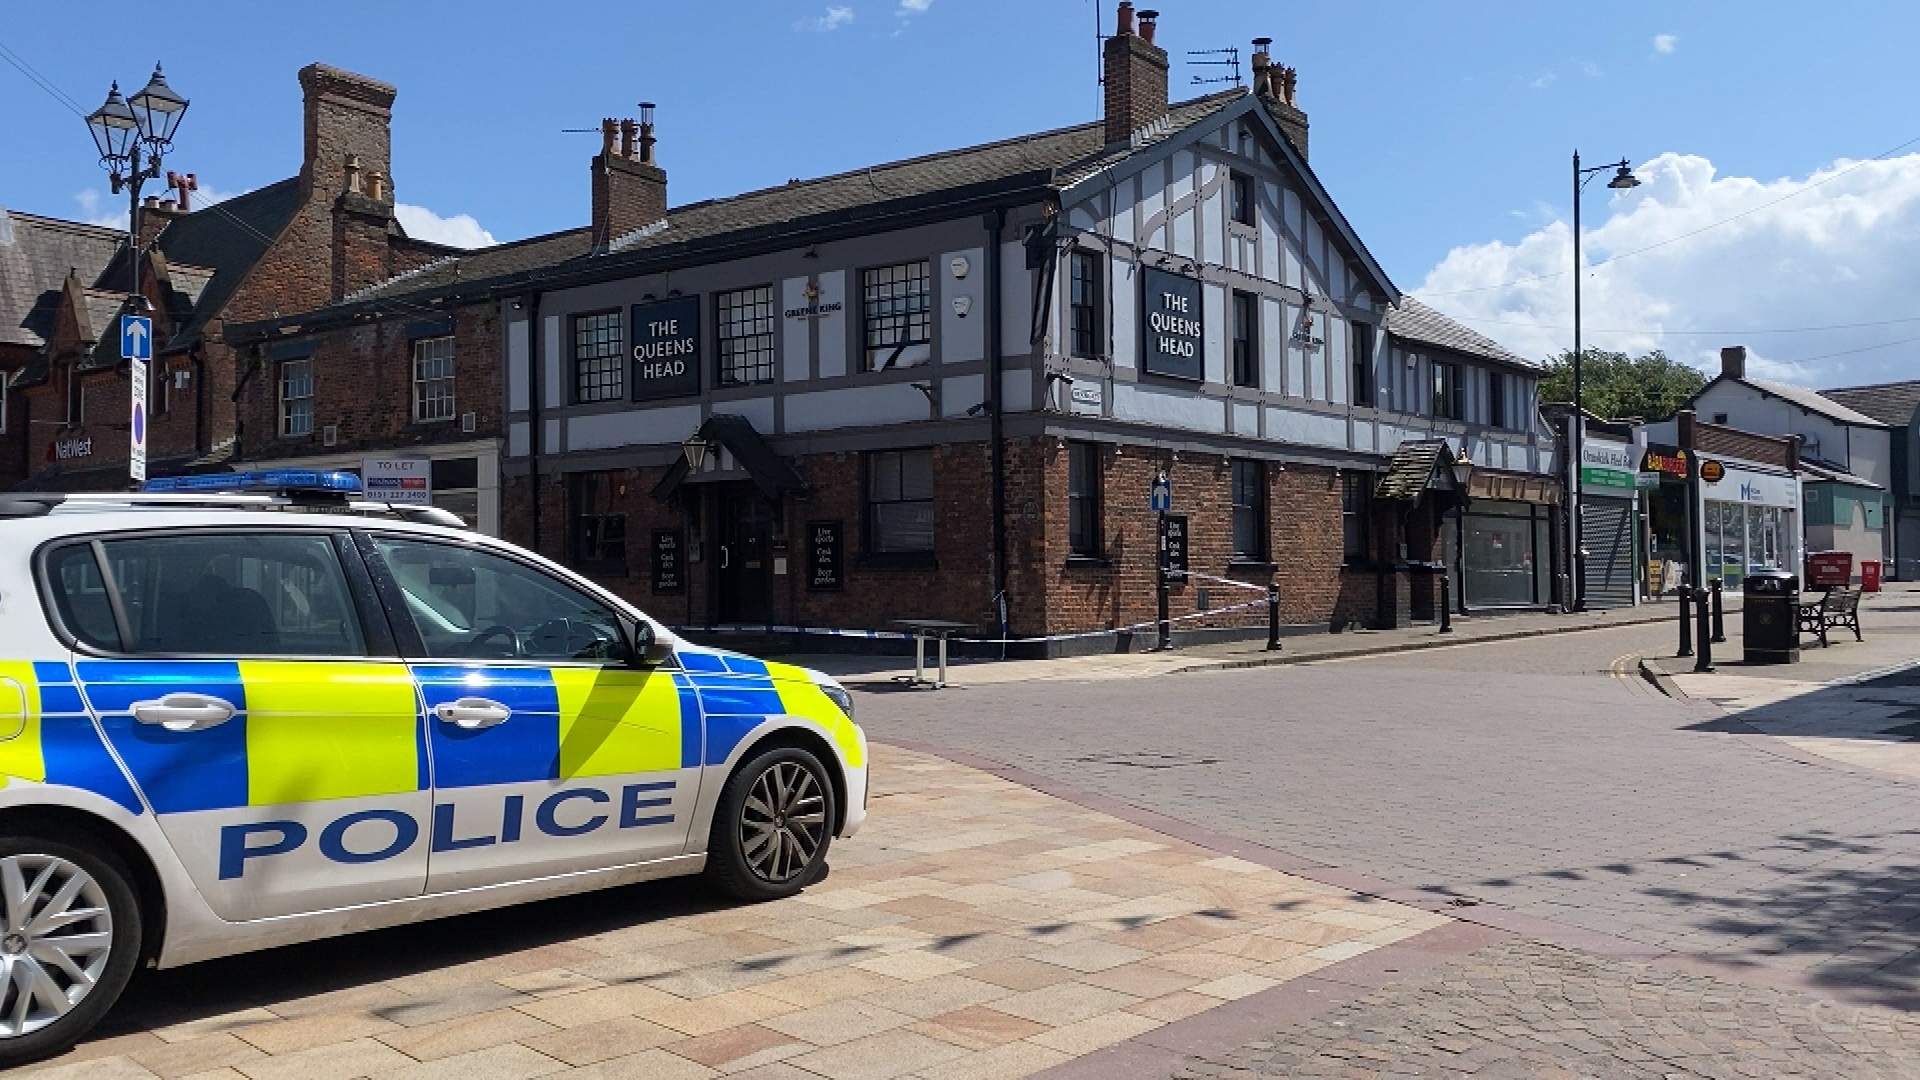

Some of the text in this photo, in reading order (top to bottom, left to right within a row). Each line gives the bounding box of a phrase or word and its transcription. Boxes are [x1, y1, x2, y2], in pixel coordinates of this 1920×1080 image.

[1163, 292, 1188, 313] THE
[819, 303, 842, 313] KING
[648, 319, 678, 337] THE
[1151, 312, 1201, 338] QUEENS
[633, 337, 694, 363] QUEENS
[1160, 336, 1194, 357] HEAD
[643, 360, 685, 379] HEAD
[55, 437, 92, 460] NatWest
[377, 462, 415, 470] TO LET
[367, 491, 387, 499] 0151
[389, 491, 405, 499] 227
[818, 528, 831, 536] Live
[815, 536, 834, 544] sports
[817, 547, 831, 555] Cask
[818, 555, 831, 563] ales
[818, 568, 833, 576] Beer
[814, 576, 836, 585] garden
[218, 780, 678, 881] POLICE
